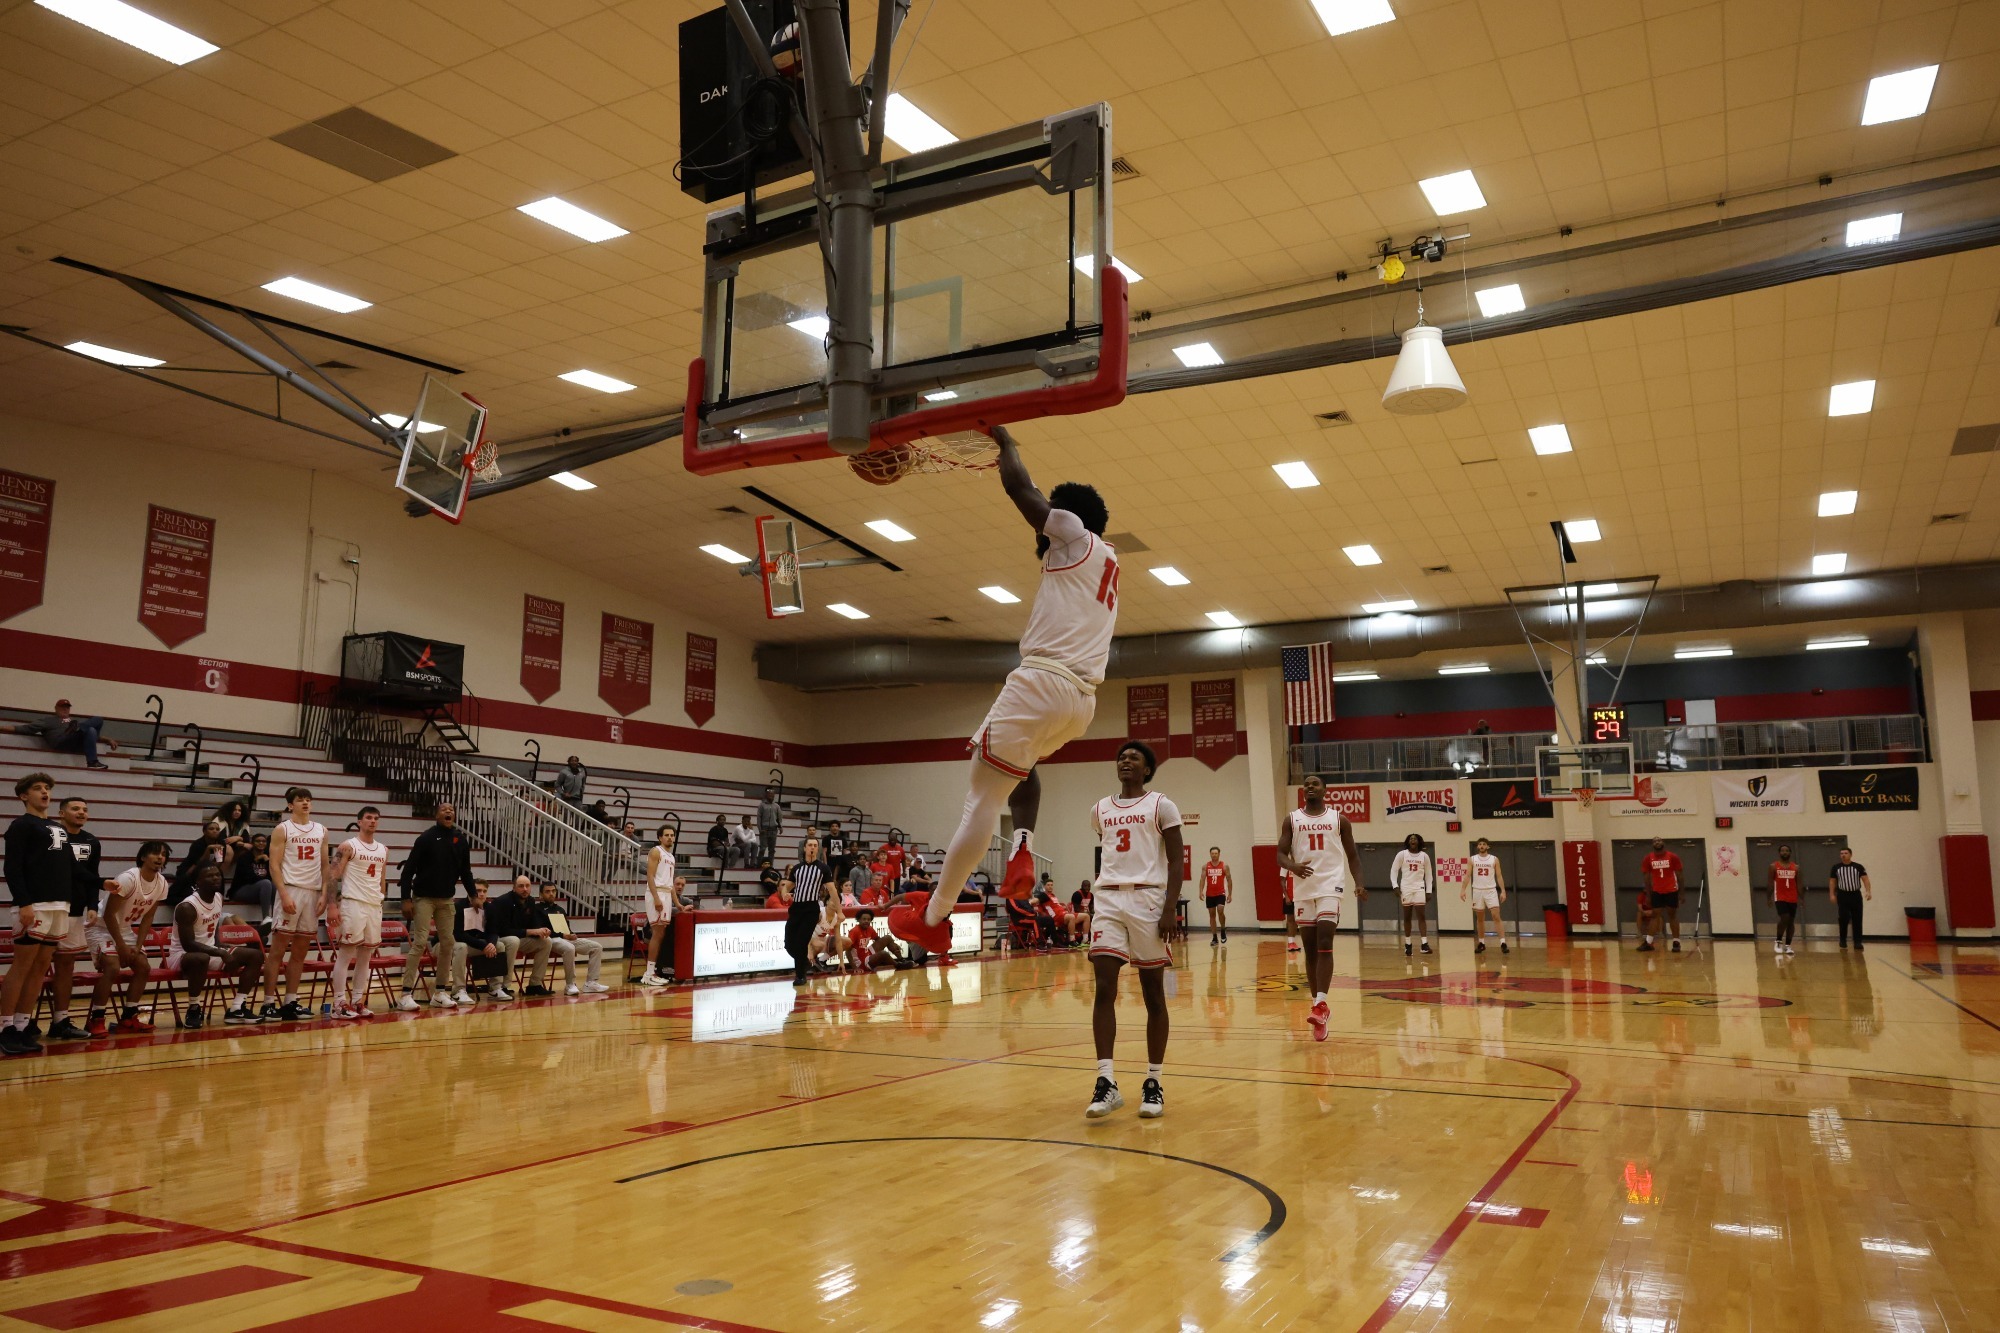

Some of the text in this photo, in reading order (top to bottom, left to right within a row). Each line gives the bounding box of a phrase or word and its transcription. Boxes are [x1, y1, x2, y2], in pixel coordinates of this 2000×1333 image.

[155, 509, 208, 532] FRIENDS
[154, 520, 208, 539] UNIVERSITY
[528, 598, 561, 613] FRIENDS
[614, 617, 642, 632] FRIENDS
[198, 658, 230, 669] SECTION
[205, 669, 220, 689] C
[405, 670, 442, 683] BSN SPORTS
[1196, 682, 1231, 691] FRIENDS
[1593, 710, 1624, 720] 14:41
[1596, 721, 1620, 740] 29
[1323, 790, 1365, 802] COWN
[1829, 793, 1912, 805] EQUITY BANK
[1622, 807, 1686, 815] alumni@friends.edu
[1104, 814, 1146, 828] FALCONS
[1298, 823, 1333, 832] FALCONS
[1449, 823, 1459, 831] EXIT
[1719, 818, 1731, 827] EXIT
[46, 825, 68, 850] F
[1116, 828, 1131, 852] 3
[1308, 833, 1325, 851] 11
[297, 845, 315, 861] 12
[359, 854, 385, 863] FALCONS
[366, 863, 376, 878] 4
[1409, 863, 1418, 872] 13
[1477, 868, 1489, 876] 23
[1577, 843, 1589, 923] FALCONS
[1297, 908, 1304, 917] F
[207, 923, 215, 939] 5
[1092, 930, 1103, 943] F
[714, 937, 731, 955] NAIA
[732, 936, 764, 957] Champions
[765, 935, 770, 951] of
[697, 963, 716, 973] RESPECT
